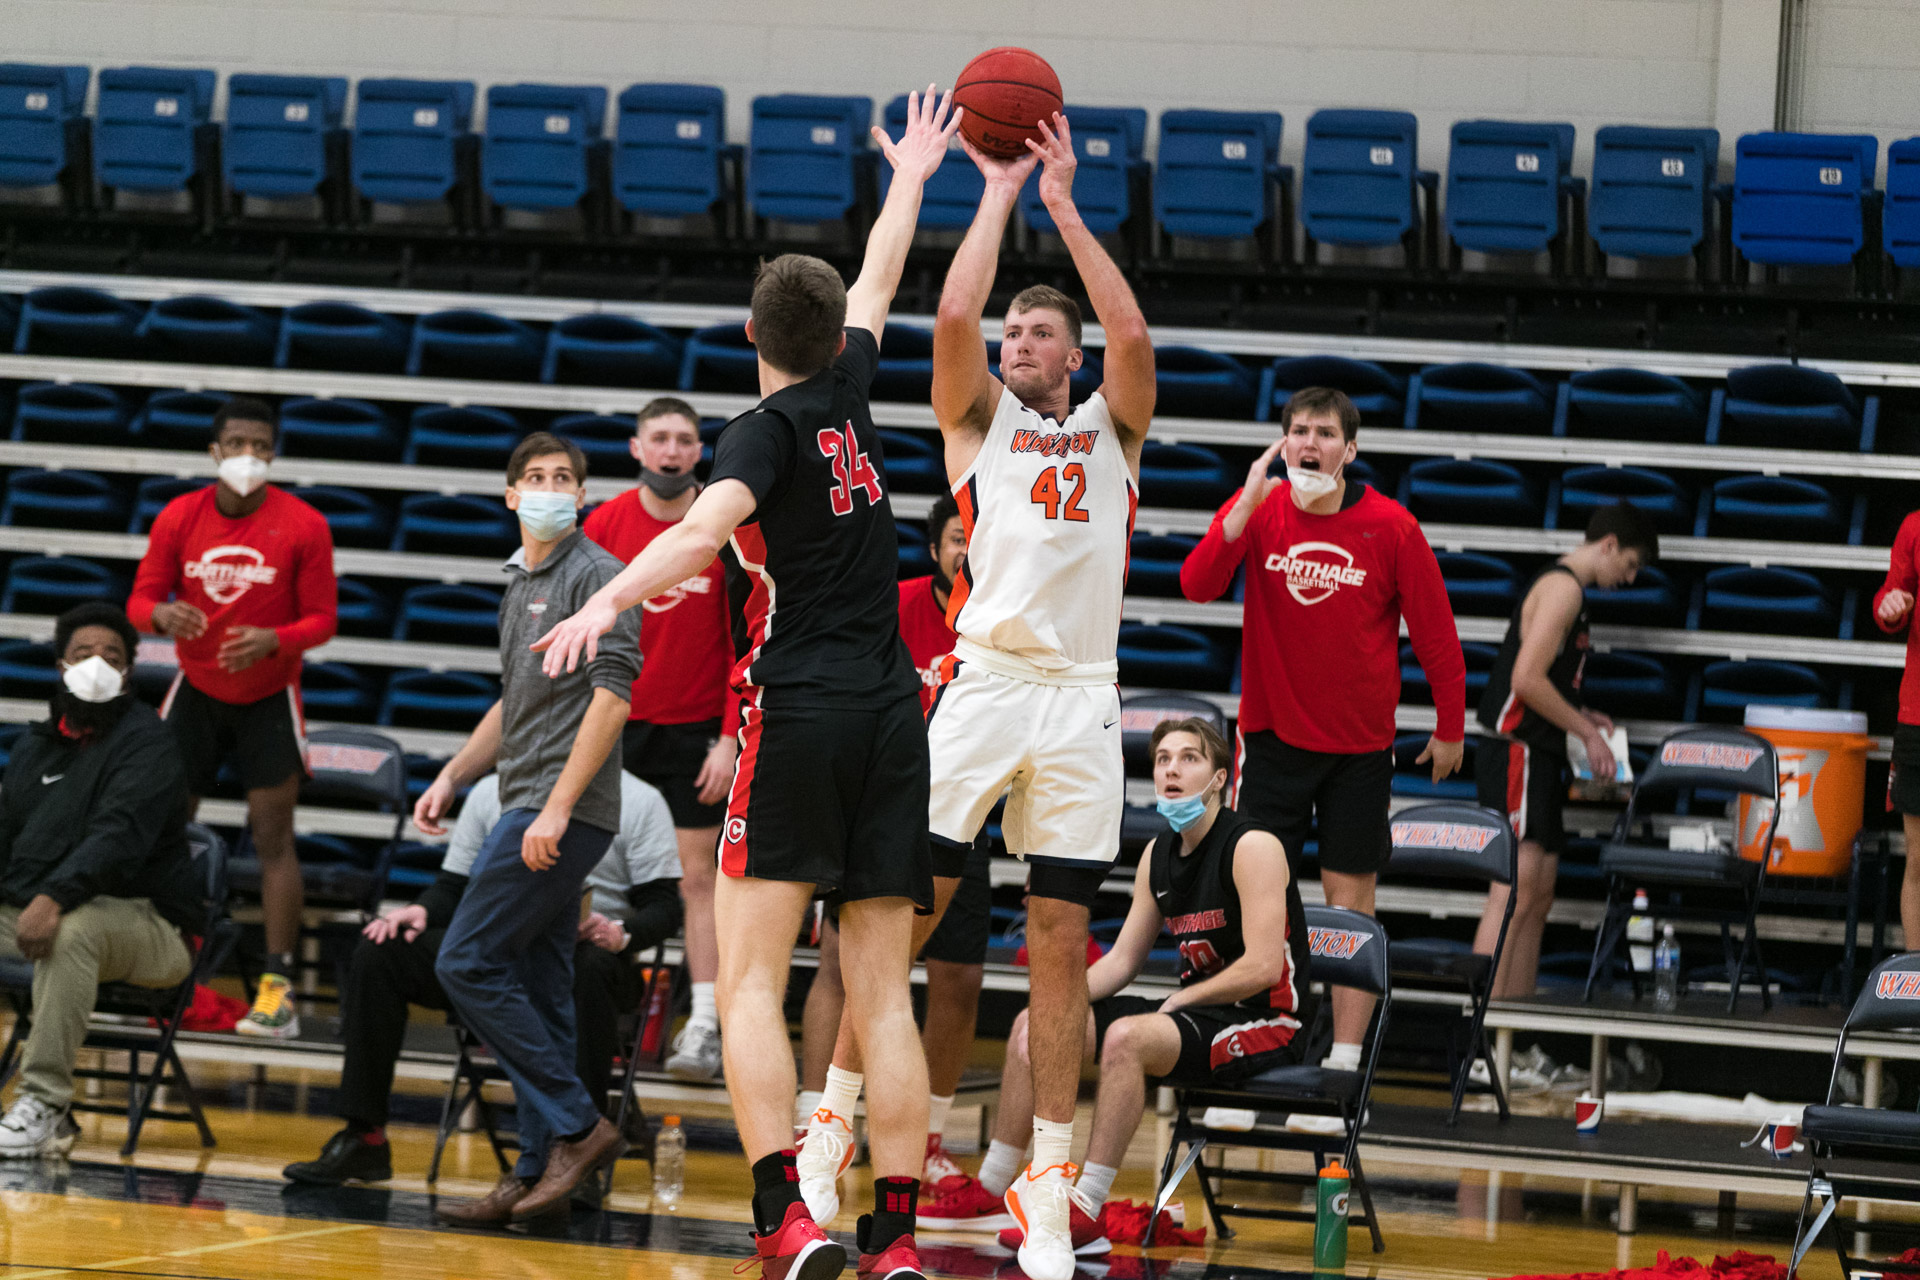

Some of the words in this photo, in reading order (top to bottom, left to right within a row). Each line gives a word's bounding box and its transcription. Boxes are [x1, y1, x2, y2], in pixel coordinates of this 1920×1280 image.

[1010, 429, 1100, 458] WHEAON
[817, 419, 882, 516] 34
[1030, 462, 1089, 522] 42
[1265, 553, 1367, 587] CARTHAGE
[1286, 575, 1340, 591] BASKETBALL
[1391, 820, 1500, 854] WHEATON
[1165, 908, 1227, 936] RTHAGE
[1307, 926, 1373, 960] ATON
